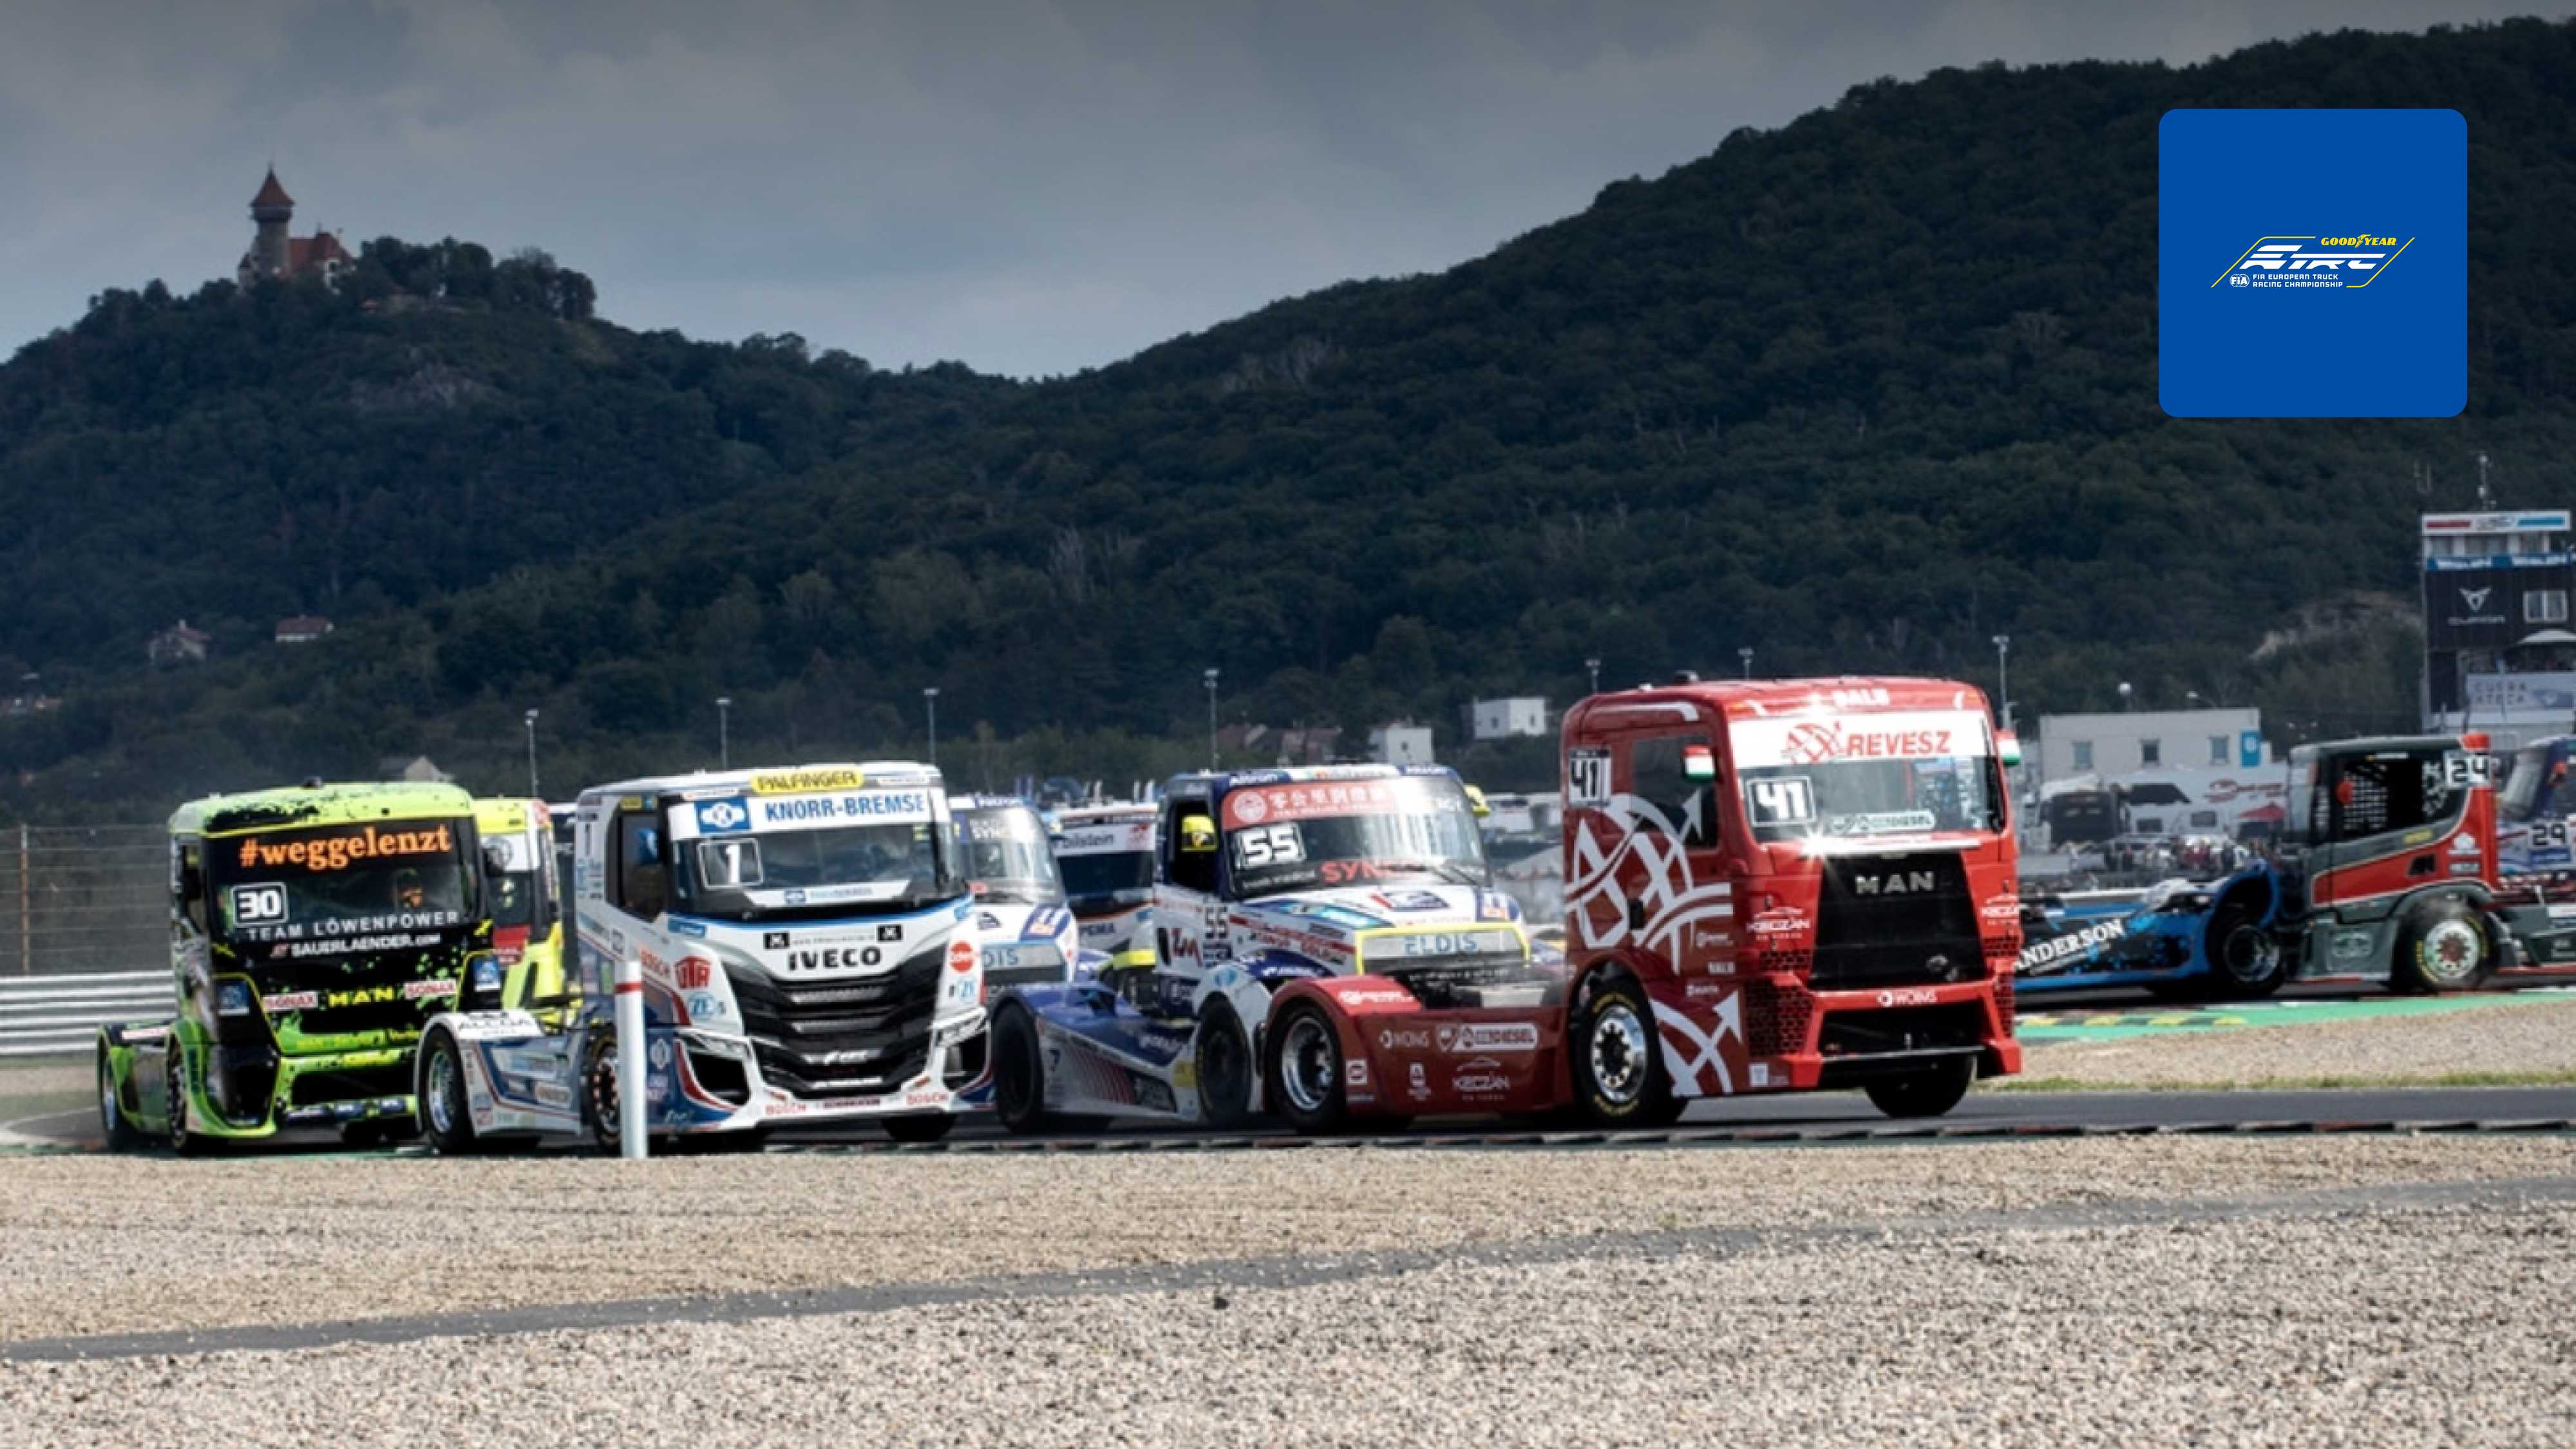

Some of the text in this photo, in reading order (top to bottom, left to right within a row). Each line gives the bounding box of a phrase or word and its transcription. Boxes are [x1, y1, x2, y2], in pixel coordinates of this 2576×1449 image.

[757, 772, 858, 791] PALFINGER
[1571, 760, 1598, 799] 41
[2449, 757, 2490, 784] 24
[764, 793, 925, 822] KNORR-BREMSE
[1756, 781, 1807, 820] 41
[239, 824, 451, 870] #weggelenzt
[1242, 826, 1300, 864] 55
[2532, 822, 2566, 846] 29
[724, 843, 740, 883] 1
[1855, 871, 1935, 895] MAN
[238, 890, 281, 920] 30
[247, 911, 460, 942] TEAM LÖWENPOWER
[788, 945, 882, 971] IVECO
[982, 948, 1019, 967] DIS
[328, 987, 394, 1008] MAN
[766, 1103, 807, 1117] BOSCH
[906, 1093, 949, 1106] BOSCH
